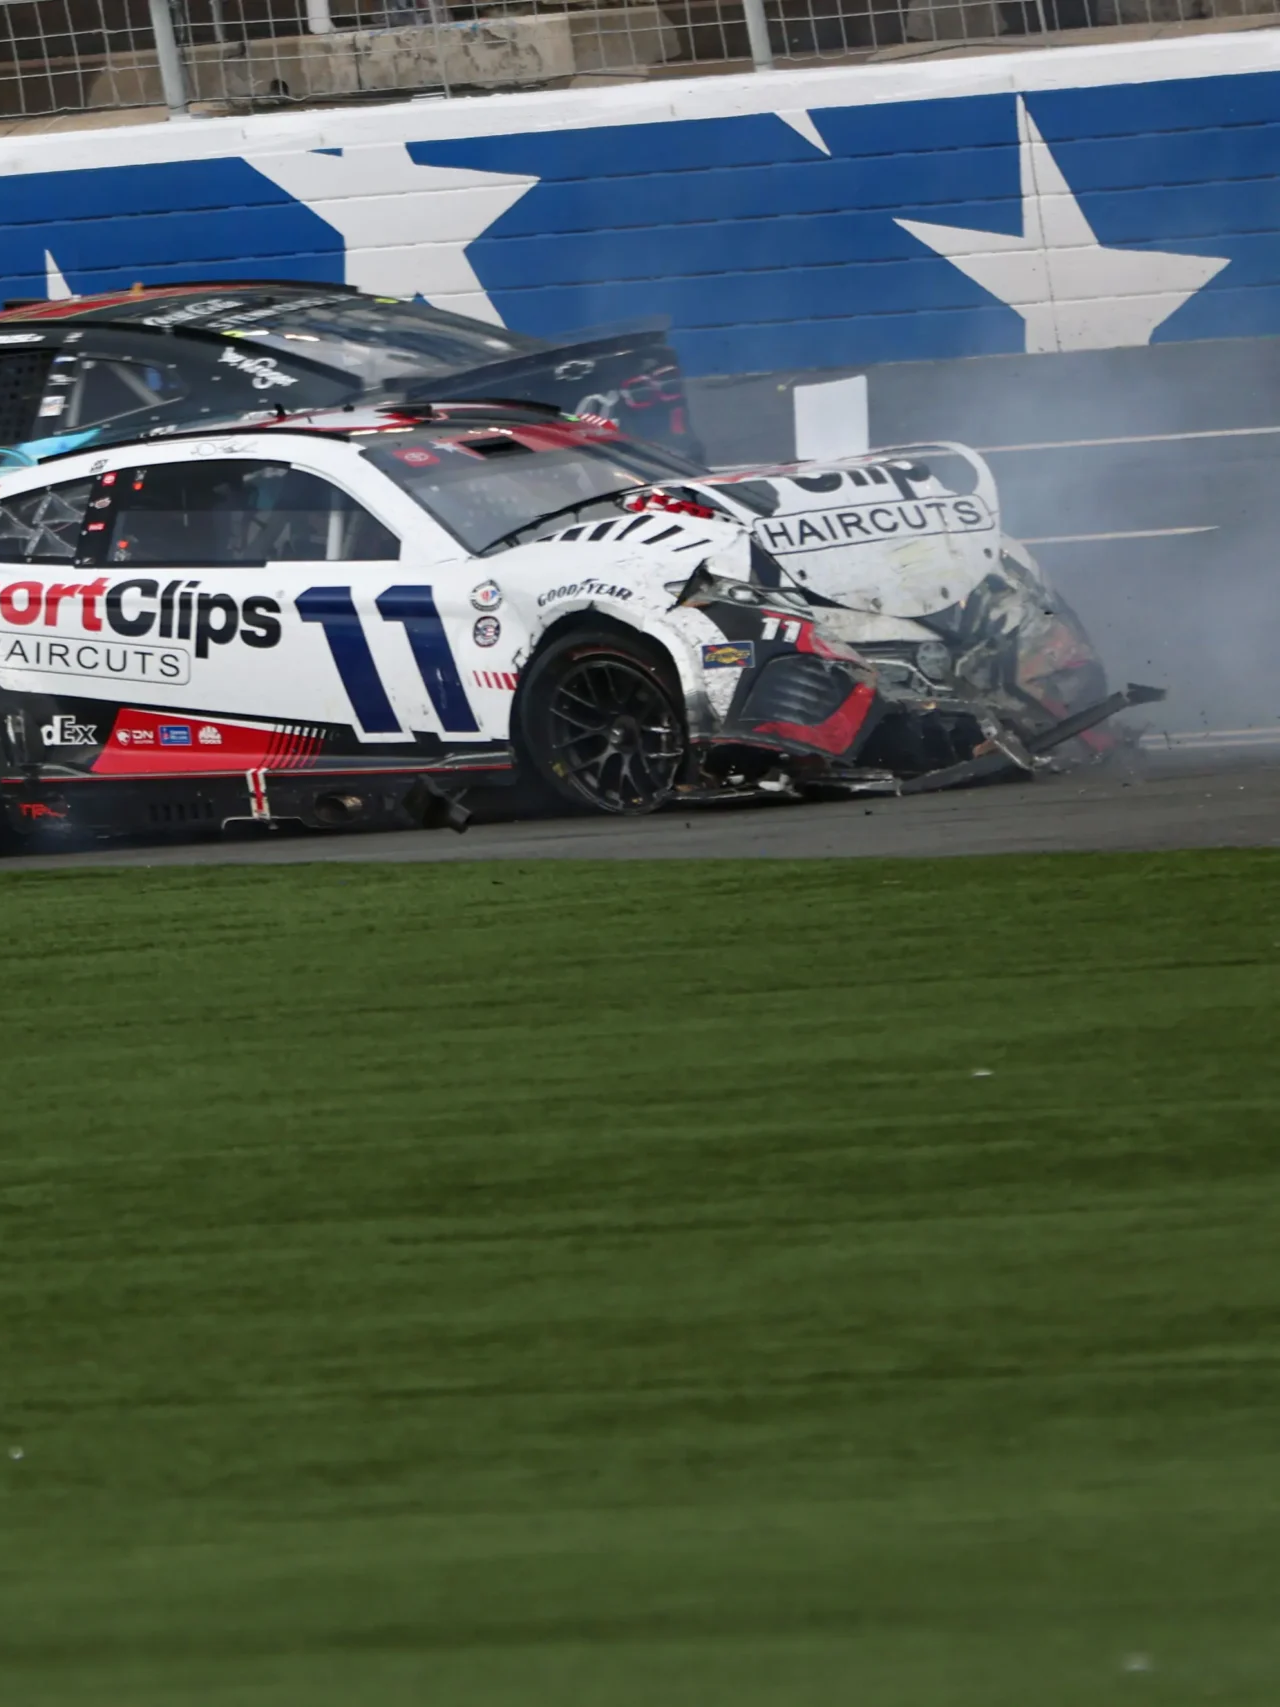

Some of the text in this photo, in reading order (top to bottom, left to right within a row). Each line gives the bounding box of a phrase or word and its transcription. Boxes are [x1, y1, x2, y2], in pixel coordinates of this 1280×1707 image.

[763, 501, 982, 548] HAIRCUTS
[761, 616, 805, 643] 11
[294, 585, 481, 733] 11
